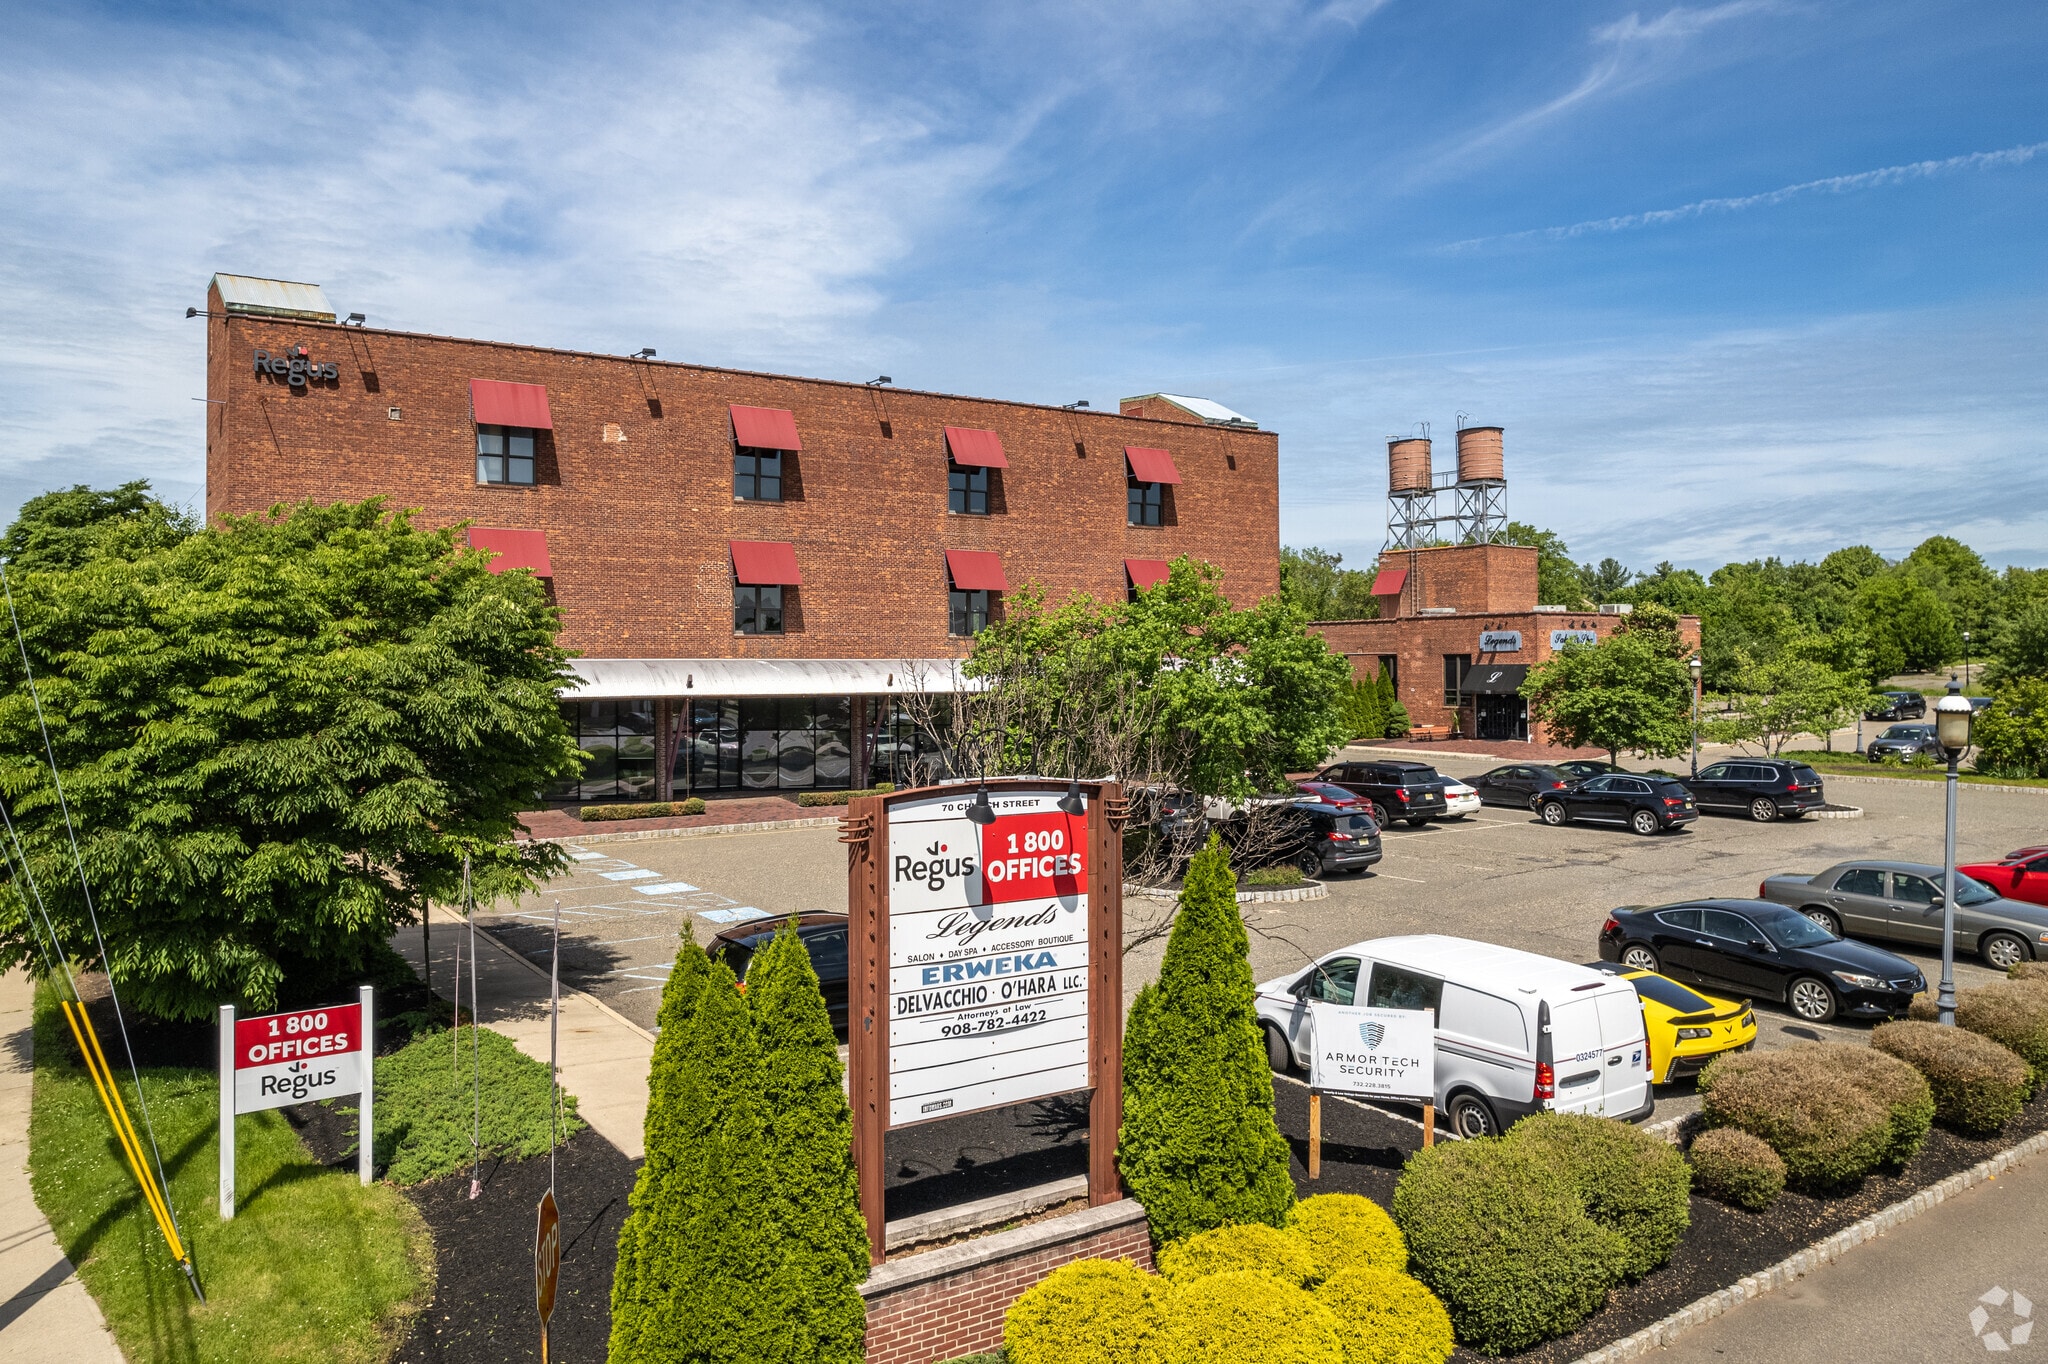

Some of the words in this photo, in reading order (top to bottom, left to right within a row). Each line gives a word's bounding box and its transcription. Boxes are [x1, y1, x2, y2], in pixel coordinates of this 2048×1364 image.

[253, 349, 338, 386] Regus
[1484, 634, 1517, 648] Legends
[941, 803, 955, 812] 70
[1002, 799, 1041, 808] STREET
[1007, 833, 1019, 854] 1
[1024, 830, 1064, 853] 800
[895, 855, 975, 891] Regus
[987, 853, 1082, 883] OFFICES
[926, 904, 1058, 946] Legends
[907, 953, 935, 963] SALON
[948, 949, 962, 960] DAY
[964, 947, 978, 957] SPA
[991, 939, 1034, 951] ACCESSORY
[1038, 934, 1074, 946] BOUTIQUE
[922, 951, 1058, 985] ERWEKA
[897, 985, 987, 1015] DELVACCHIO
[1001, 975, 1057, 999] O'HARA
[1063, 975, 1082, 990] LLC.
[268, 1020, 280, 1037] 1
[286, 1013, 328, 1034] 800
[941, 1010, 1047, 1036] 908-782-4422
[957, 1008, 999, 1021] Attorneys
[1003, 1006, 1011, 1014] at
[1015, 1003, 1032, 1012] Law
[249, 1033, 348, 1062] OFFICES
[1326, 1052, 1377, 1065] ARMOR
[1382, 1056, 1420, 1067] TECH
[1576, 1049, 1603, 1062] 0324577
[261, 1069, 336, 1099] Regus
[1340, 1065, 1405, 1077] SECURITY
[538, 1222, 558, 1298] STOP
